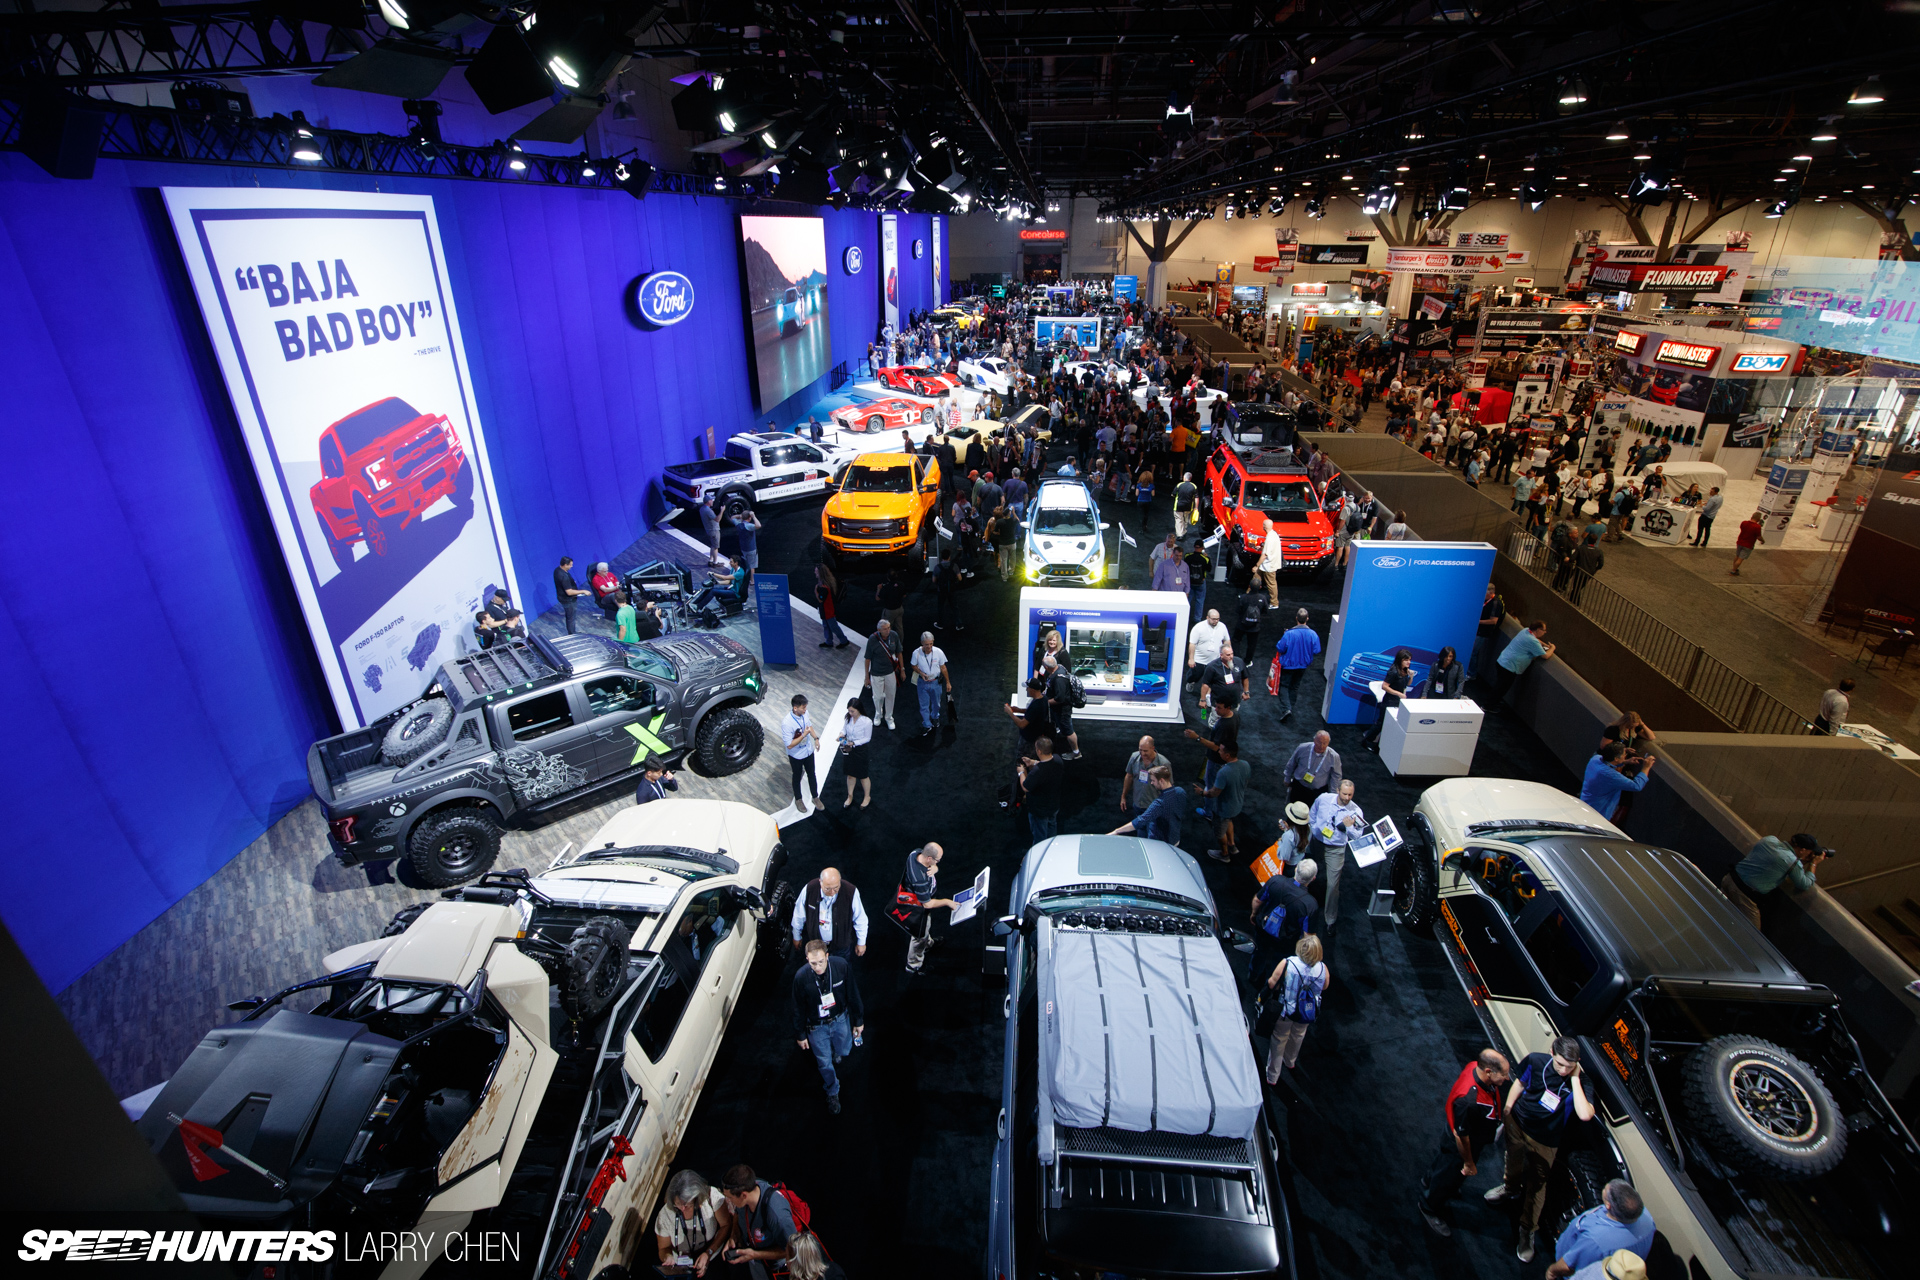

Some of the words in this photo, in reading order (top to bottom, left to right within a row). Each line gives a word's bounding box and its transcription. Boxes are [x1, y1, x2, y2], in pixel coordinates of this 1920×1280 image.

[1020, 230, 1066, 239] Concourse
[1317, 252, 1335, 261] US
[1590, 266, 1632, 285] FLOWMASTER
[1639, 270, 1718, 290] FLOWMASTER
[652, 280, 686, 315] Ford
[274, 312, 354, 361] BAD
[427, 346, 441, 355] DRIVE
[1657, 342, 1711, 362] FLOWMASTER
[1737, 356, 1786, 368] B&M
[1603, 402, 1626, 410] B&M
[1647, 512, 1670, 528] 35
[1378, 557, 1401, 567] Ford
[355, 638, 370, 651] FORD
[370, 629, 385, 644] F-150
[384, 616, 405, 635] RAPTOR
[371, 790, 416, 806] PROJECT
[1603, 1042, 1630, 1077] ADDICTIVE
[1729, 1050, 1788, 1065] BFGoodrich
